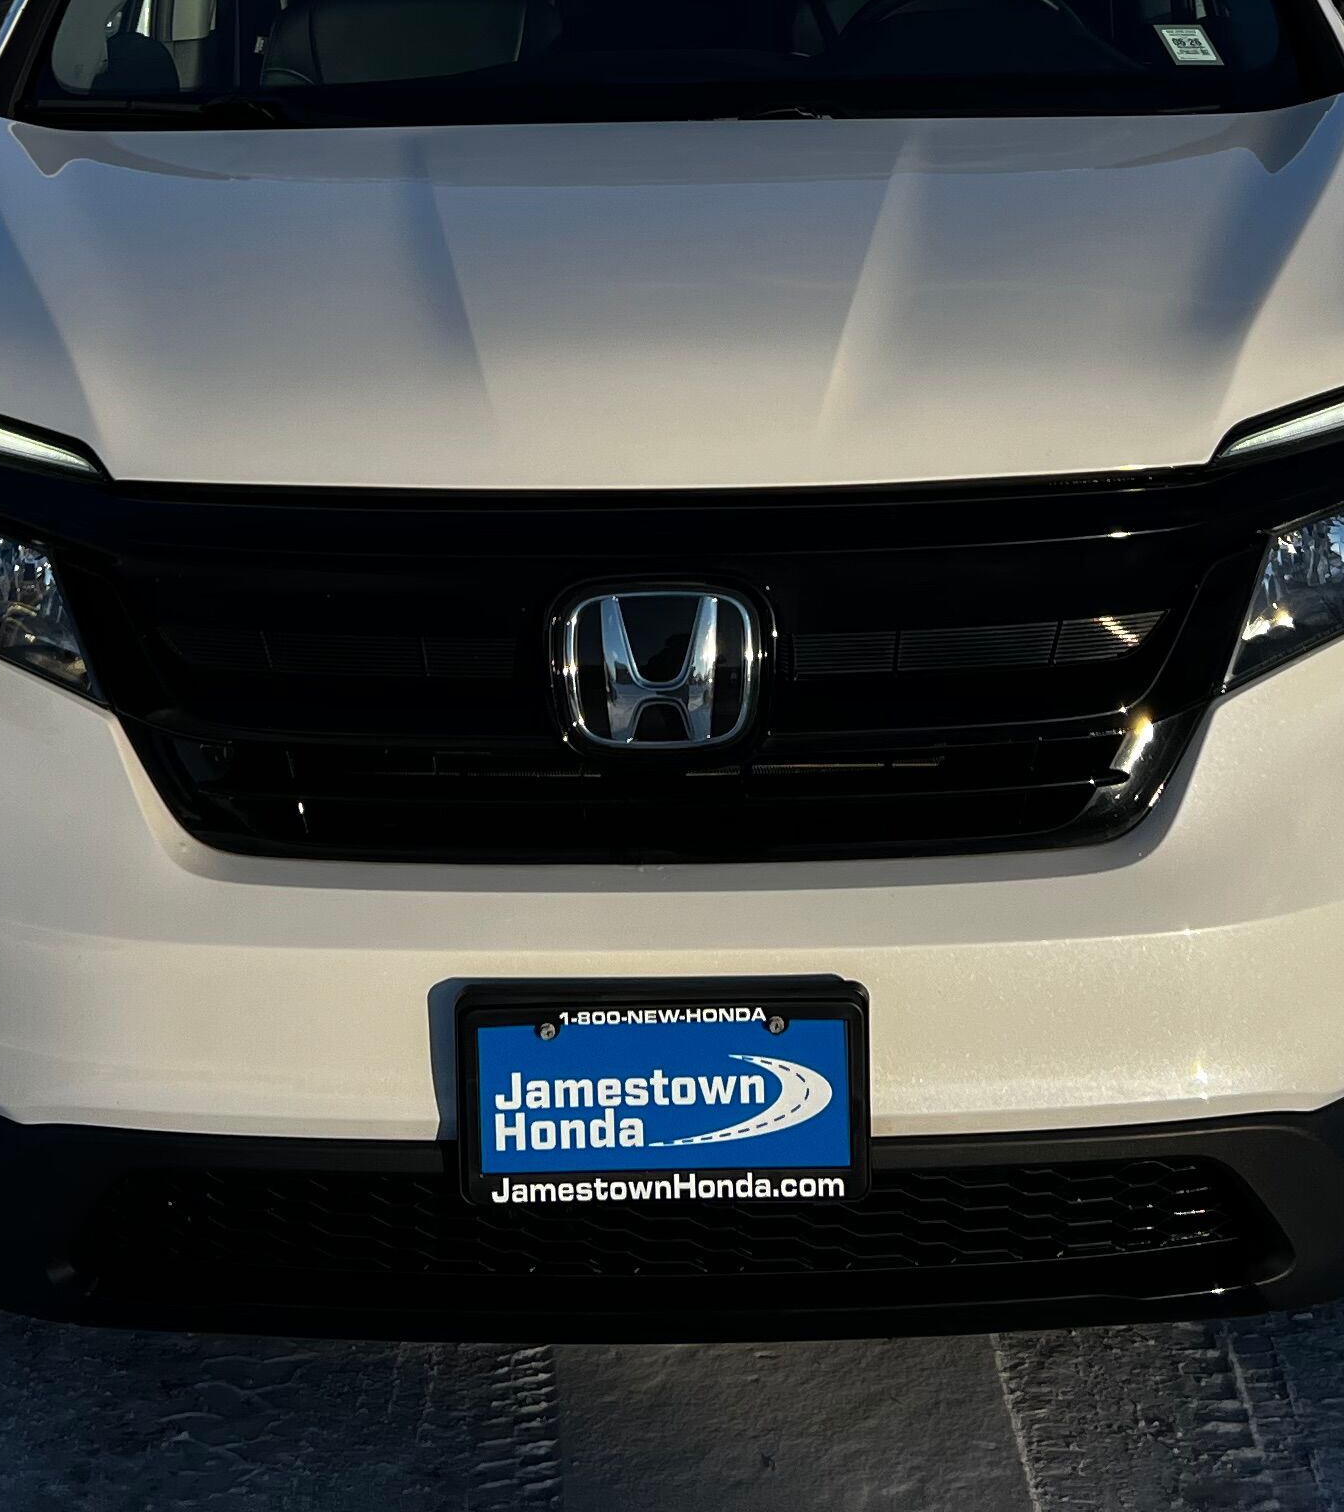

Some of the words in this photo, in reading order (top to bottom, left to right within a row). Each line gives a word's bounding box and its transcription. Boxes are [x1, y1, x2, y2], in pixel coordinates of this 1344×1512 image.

[558, 1006, 767, 1026] 1-800-NEW-HONDA
[494, 1069, 766, 1111] Jamestown
[494, 1108, 645, 1152] Honda
[491, 1172, 846, 1204] JamestownHonda.com
